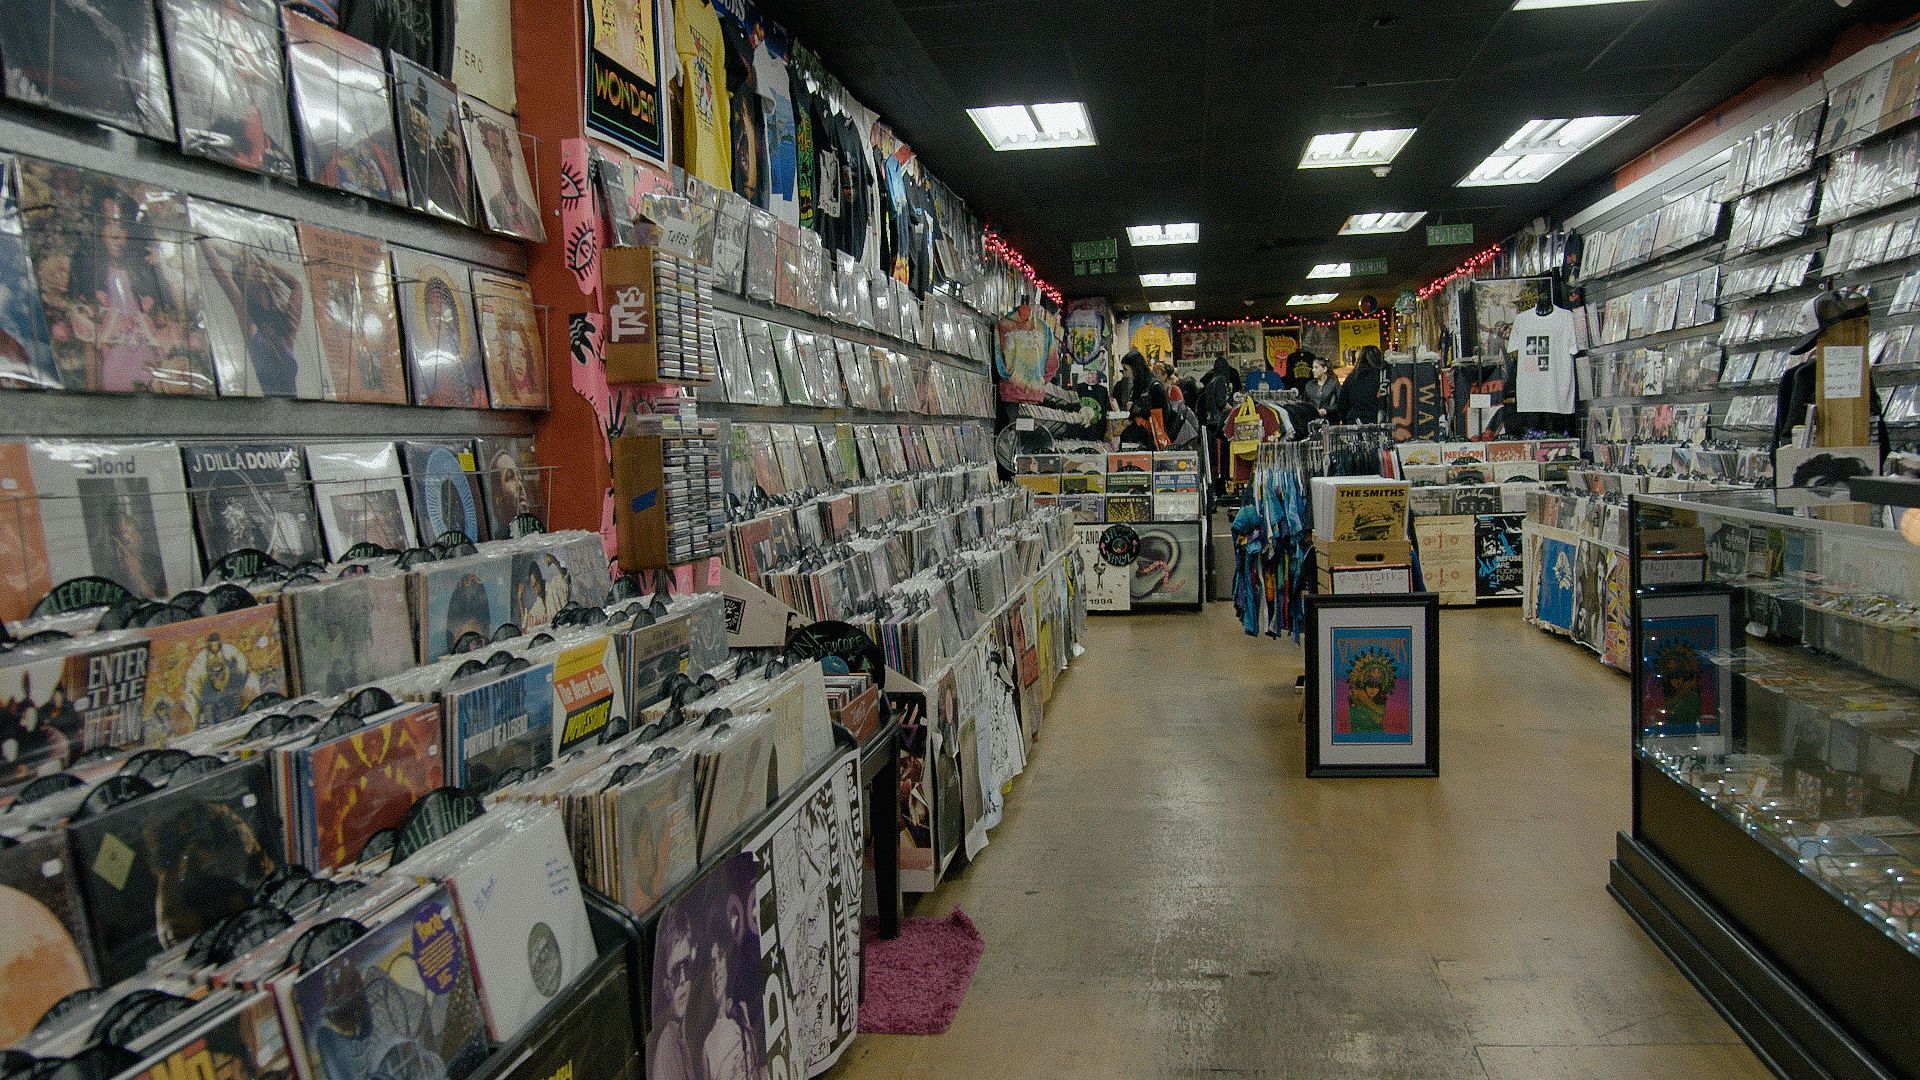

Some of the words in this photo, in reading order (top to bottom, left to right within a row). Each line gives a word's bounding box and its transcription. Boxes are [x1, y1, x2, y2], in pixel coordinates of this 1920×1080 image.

[594, 62, 656, 125] WONDER
[668, 230, 690, 246] TAPES
[193, 454, 202, 474] J
[205, 452, 247, 472] DILLA
[1444, 450, 1484, 459] NELSON
[1338, 490, 1362, 499] THE
[1363, 489, 1405, 498] SMITHS
[226, 558, 259, 579] SOUL
[1107, 551, 1134, 565] VINYL
[89, 648, 147, 690] ENTER
[88, 678, 145, 709] THE
[824, 786, 841, 888] FRONT
[834, 899, 850, 1033] AGNOSTIC
